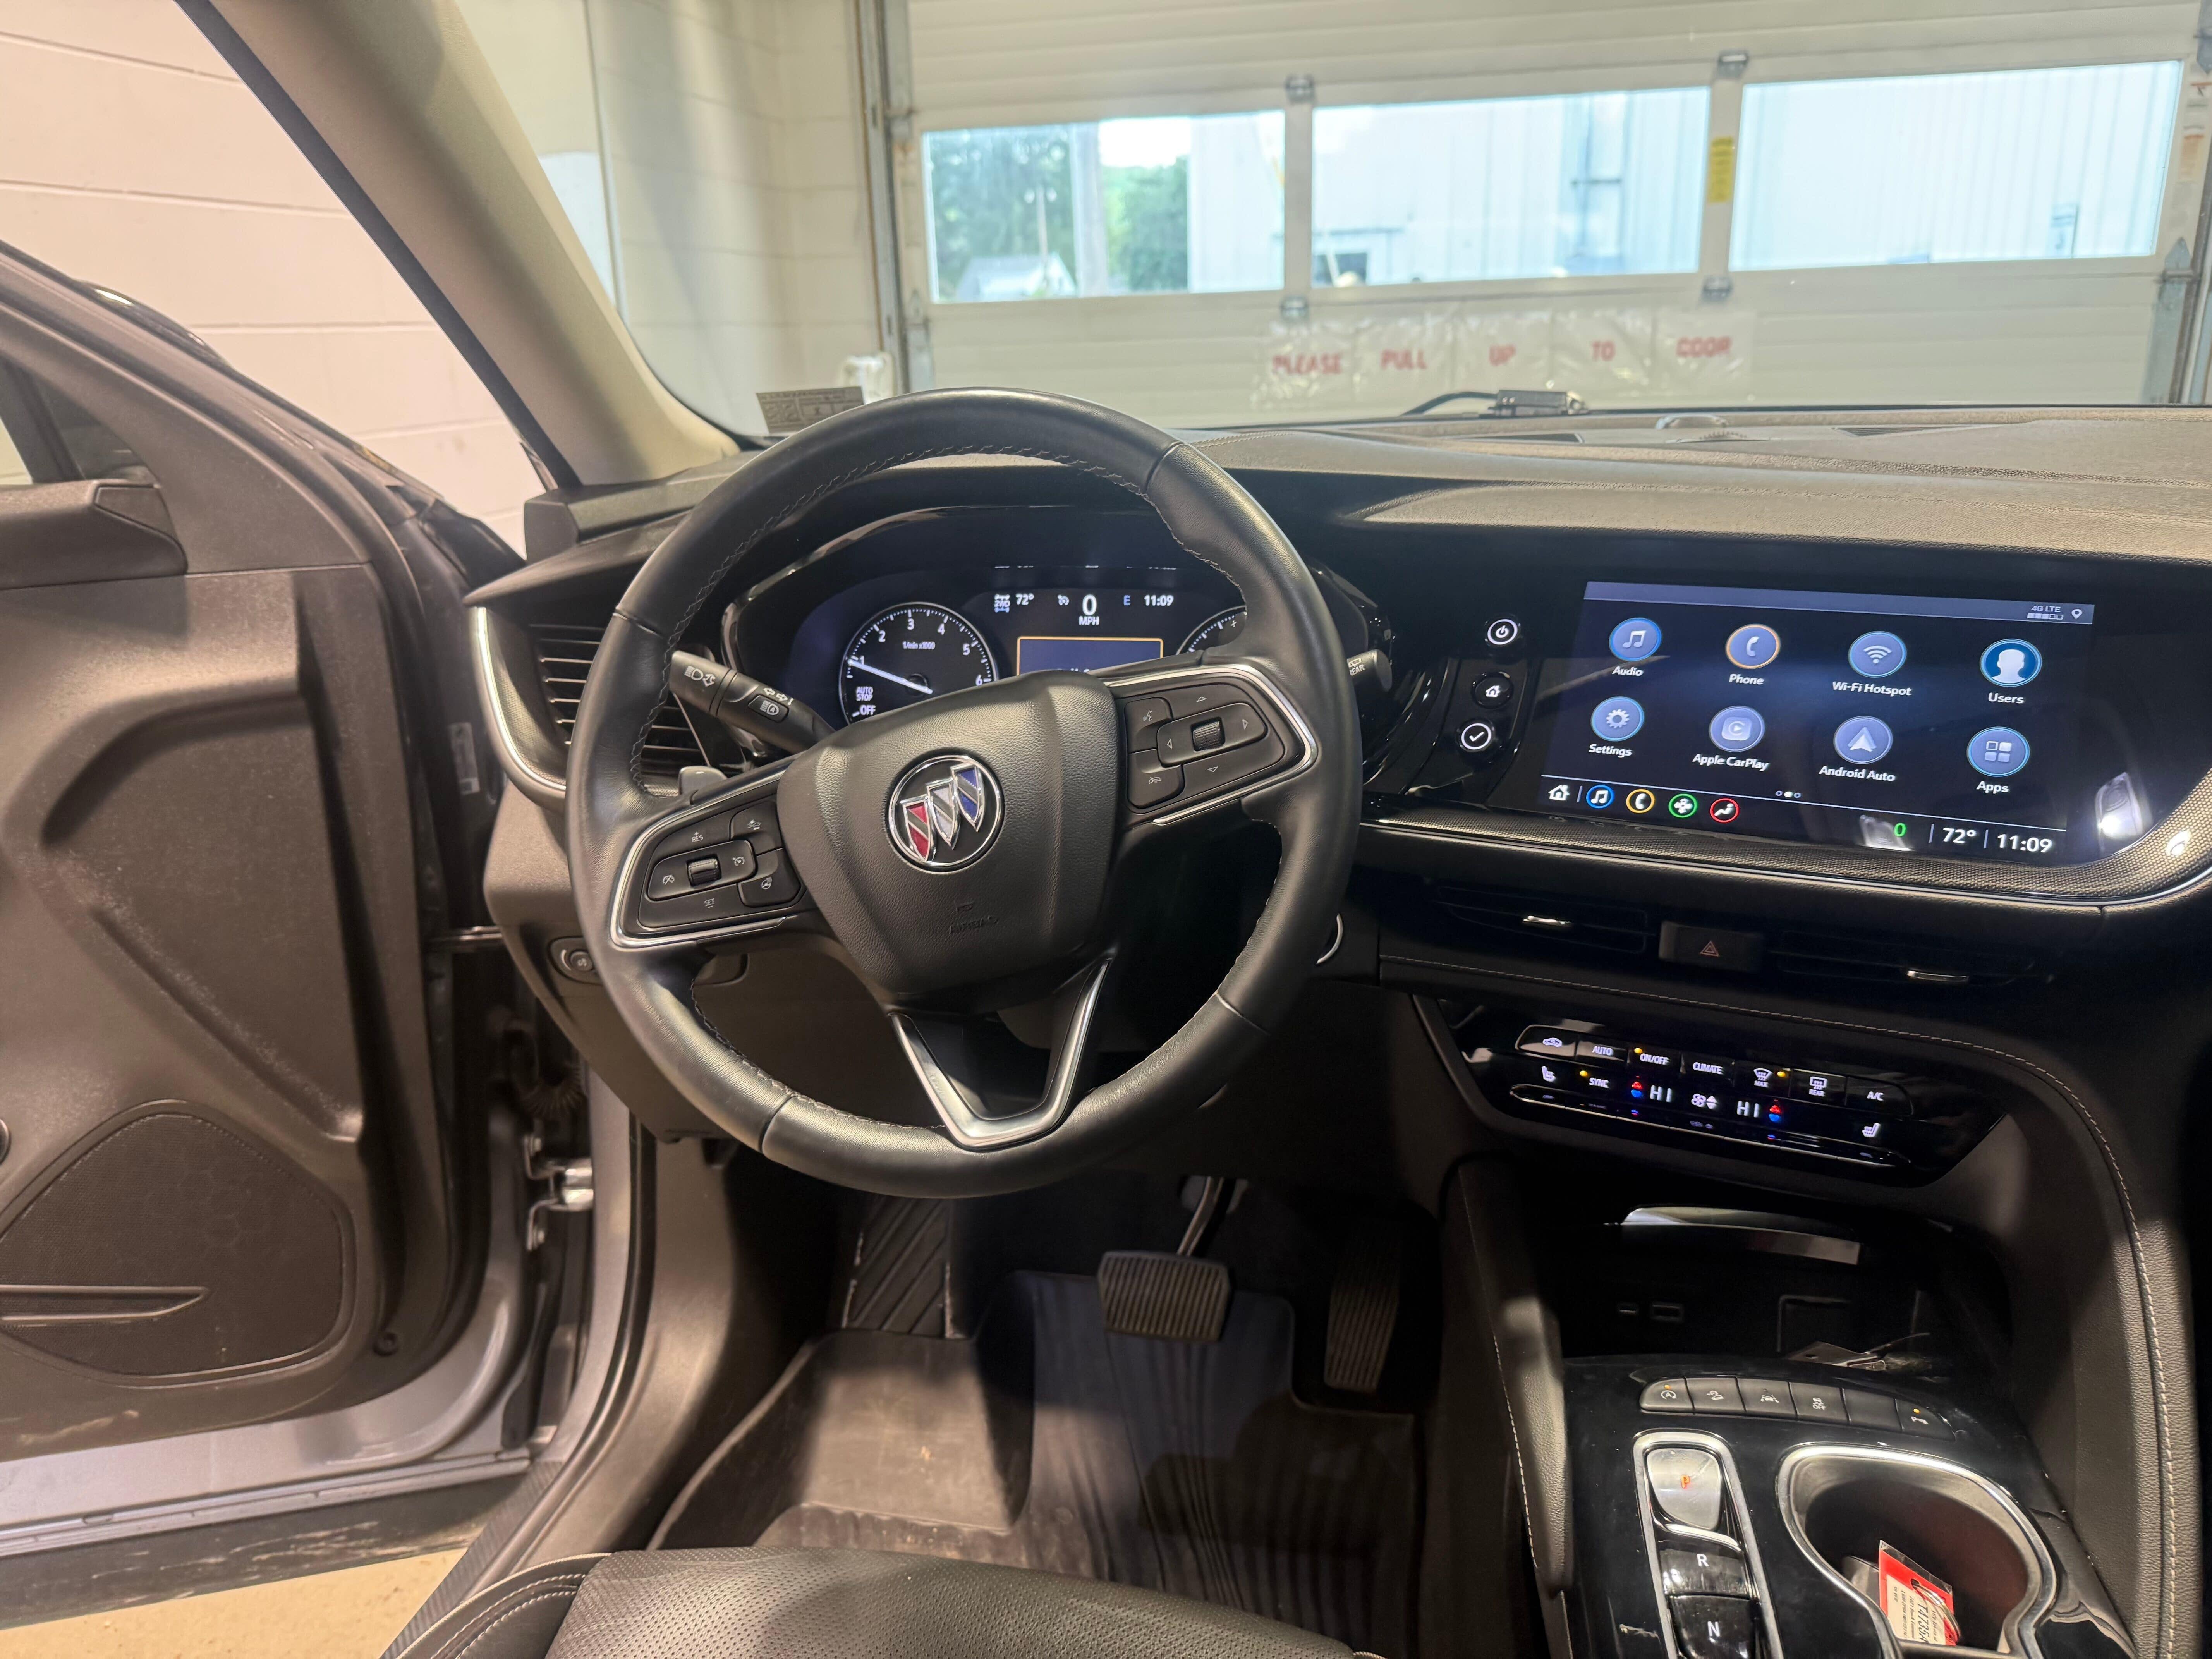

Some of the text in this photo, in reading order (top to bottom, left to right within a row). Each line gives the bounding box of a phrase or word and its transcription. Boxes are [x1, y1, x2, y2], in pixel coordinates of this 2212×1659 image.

[1272, 351, 1343, 376] PLEASE
[1380, 349, 1427, 371] PULL
[1489, 343, 1516, 366] UP
[1592, 339, 1616, 362] TO
[1083, 594, 1097, 616] 0
[1123, 595, 1131, 606] E
[1144, 594, 1174, 606] 11:09
[907, 619, 914, 630] 3
[1078, 616, 1100, 625] MPH
[938, 623, 945, 635] 4
[878, 630, 886, 642] 2
[963, 643, 970, 655] 5
[860, 656, 865, 665] 1
[1612, 666, 1644, 677] Audio
[975, 674, 983, 686] 6
[1729, 674, 1765, 685] Phone
[1832, 681, 1913, 697] Wi-Fi Hotspot
[856, 693, 873, 701] STOP
[1987, 692, 2025, 704] Users
[859, 705, 876, 715] OFF
[1589, 744, 1633, 758] Settings
[1692, 754, 1770, 771] Apple CarPlay
[1818, 766, 1896, 782] Android Auto
[1976, 781, 2009, 794] Apps
[1942, 827, 1977, 844] 72°
[1997, 833, 2053, 853] 11:09
[1592, 1046, 1614, 1056] AUTO
[1640, 1053, 1670, 1065] ON/OFF
[1692, 1061, 1723, 1075] CLIMATE
[1589, 1077, 1610, 1089] SYNC
[1808, 1089, 1826, 1097] REAR
[1867, 1091, 1884, 1102] A/C
[1681, 1474, 1690, 1488] P
[1697, 1554, 1709, 1567] R
[1707, 1621, 1721, 1637] N
